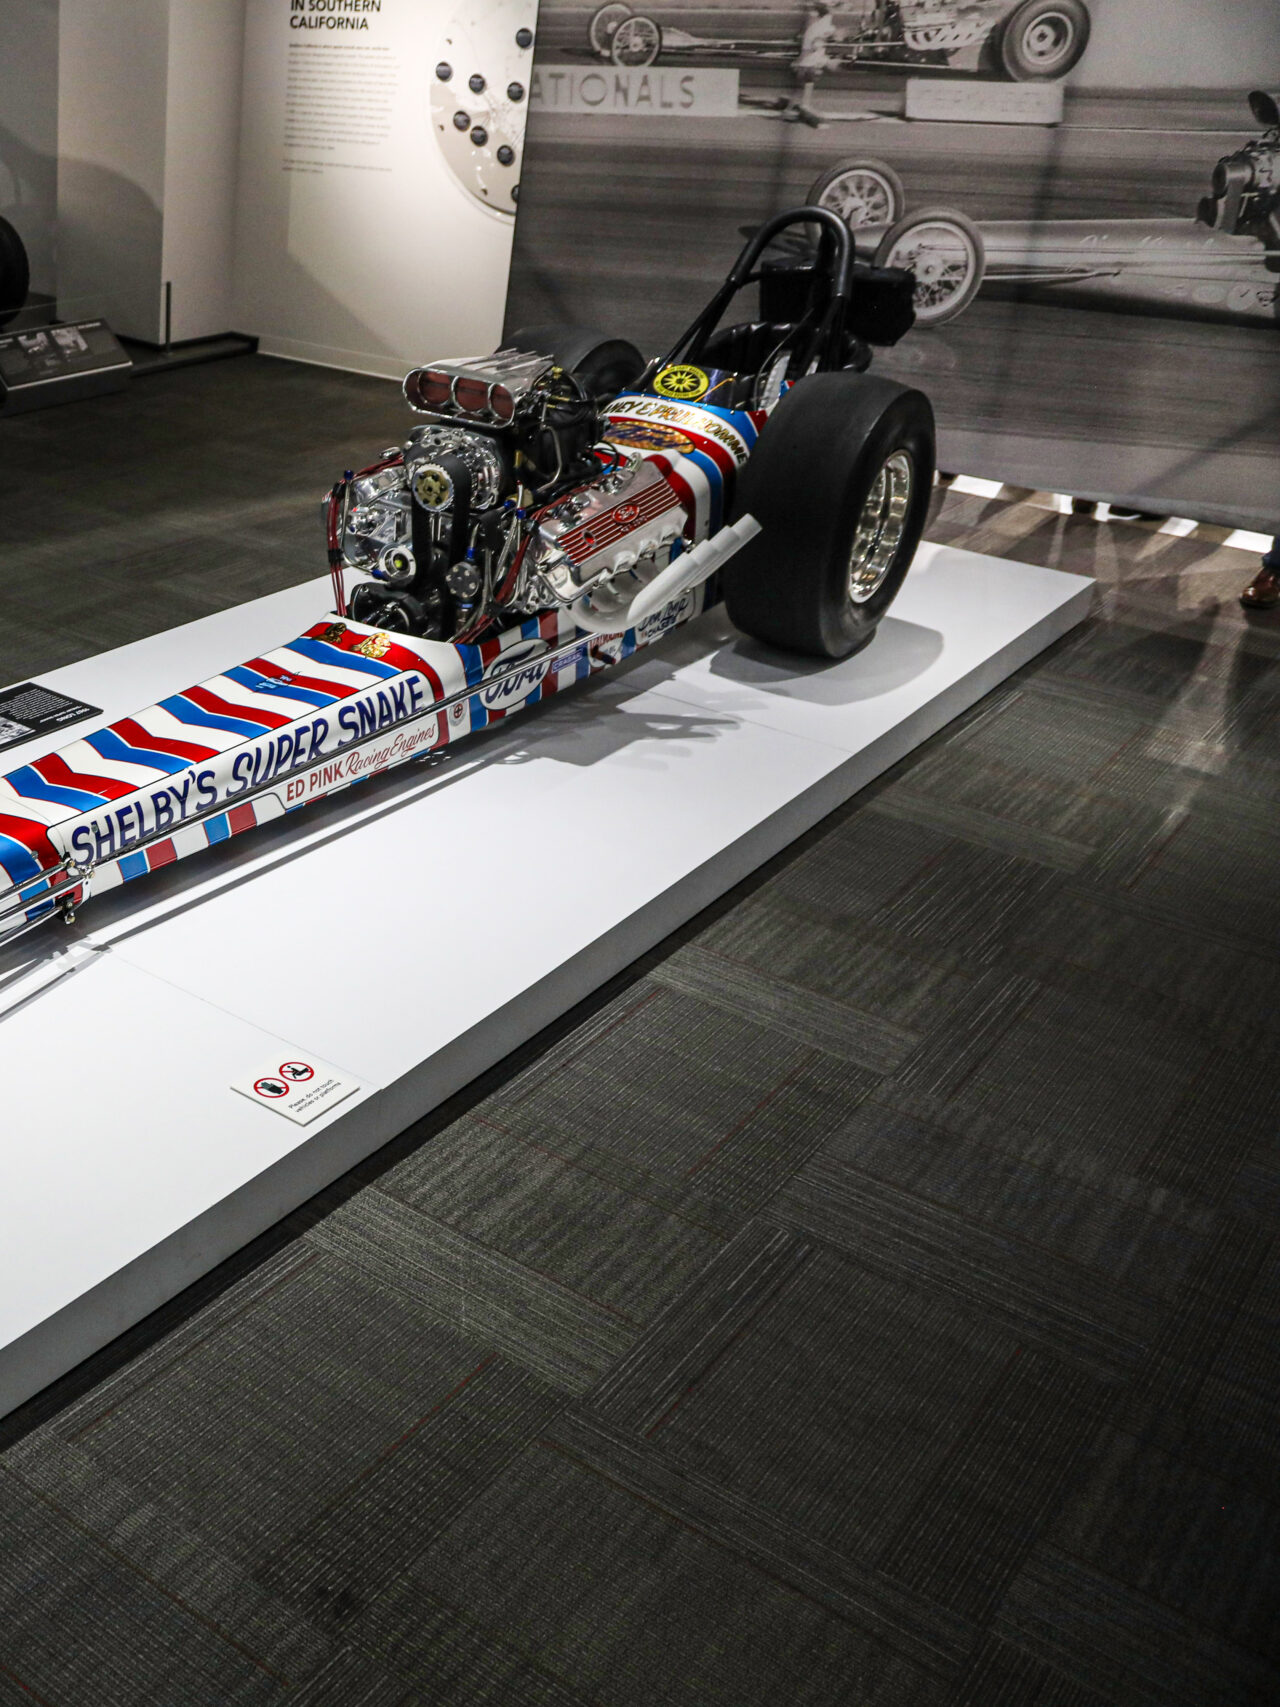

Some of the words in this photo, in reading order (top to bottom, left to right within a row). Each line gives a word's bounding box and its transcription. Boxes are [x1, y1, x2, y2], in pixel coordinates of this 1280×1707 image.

[290, 0, 305, 11] IN
[308, 0, 381, 12] SOUTHERN
[290, 15, 369, 30] CALIFORNIA
[485, 644, 547, 704] Ford
[71, 769, 218, 866] SHELBY'S
[225, 717, 329, 798] SUPER
[337, 675, 424, 747] SNAKE
[286, 779, 305, 802] ED
[309, 760, 344, 792] PINK
[345, 746, 391, 776] Racing
[387, 723, 437, 757] Engines
